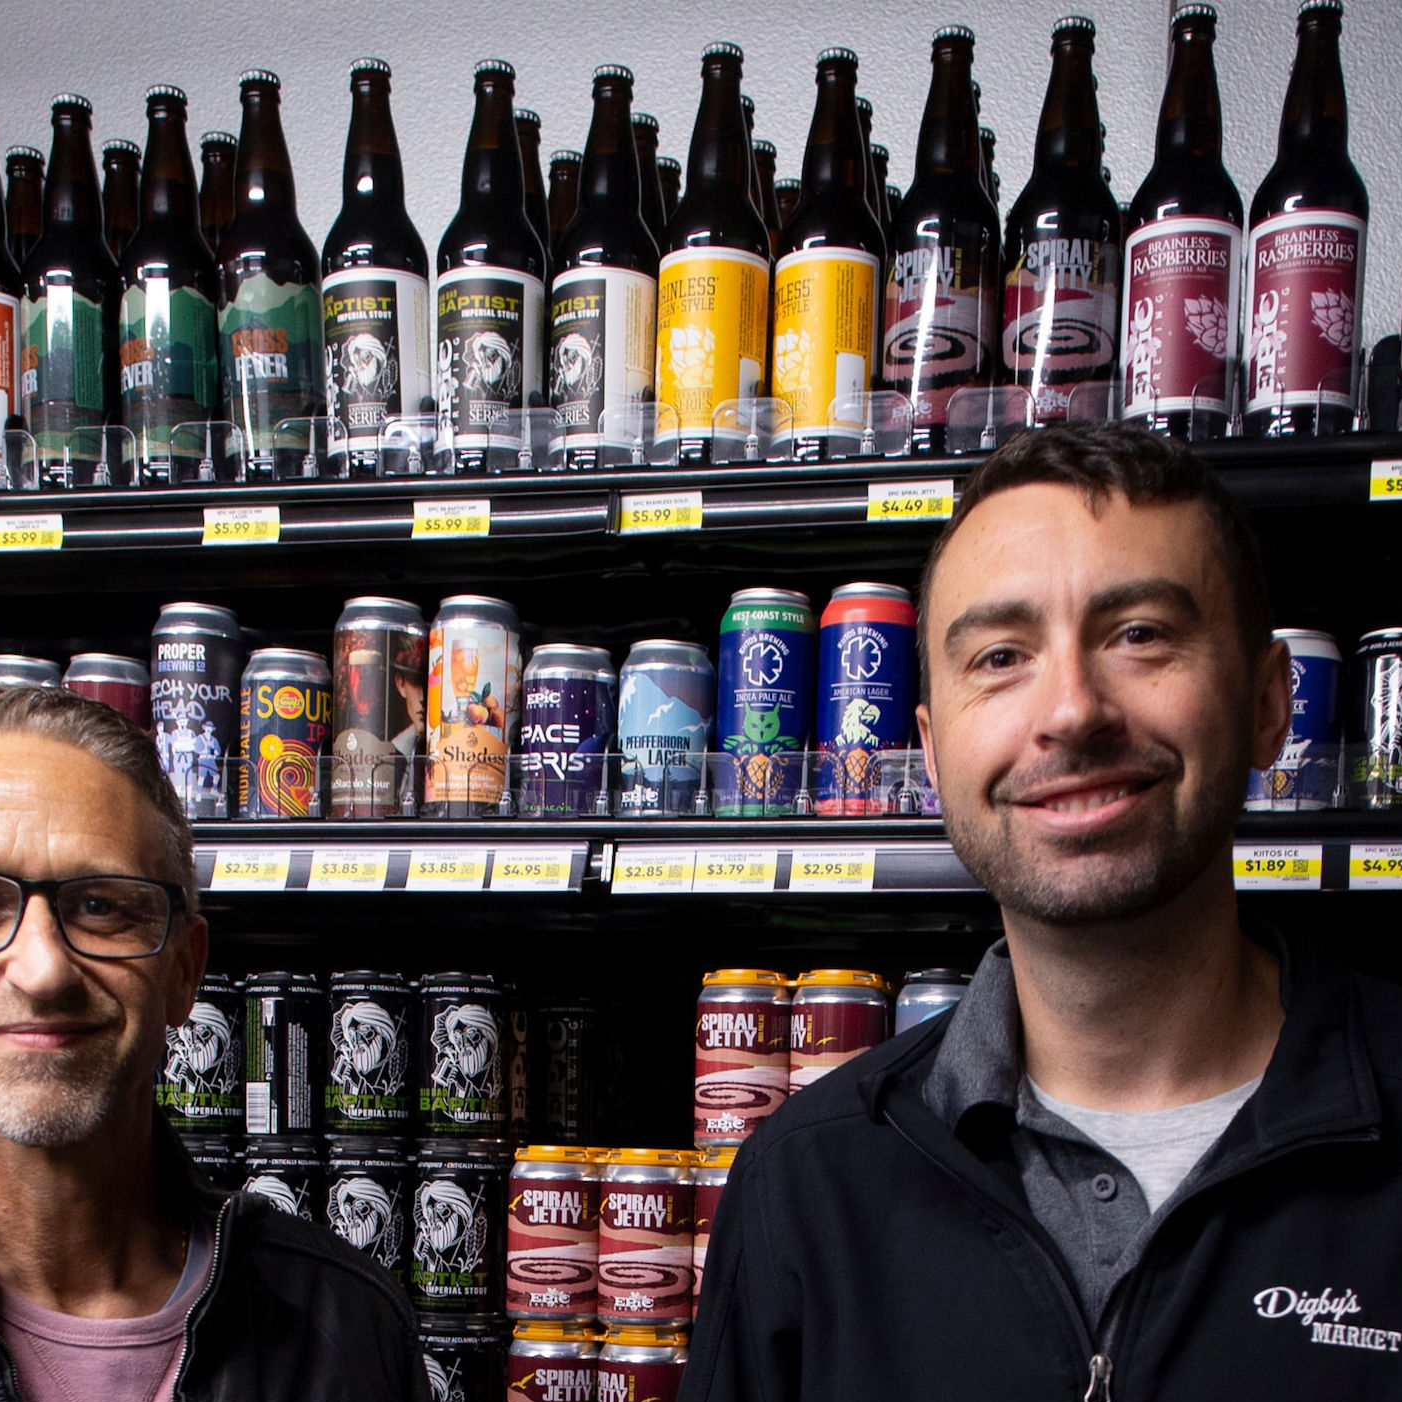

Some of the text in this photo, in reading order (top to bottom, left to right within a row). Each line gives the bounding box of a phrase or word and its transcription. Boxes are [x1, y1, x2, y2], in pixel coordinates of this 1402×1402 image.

[1274, 229, 1340, 247] BRAINLESS
[1027, 238, 1091, 268] SPIRAL
[1148, 237, 1211, 256] BRAINLESS
[1133, 251, 1227, 278] RASPBERRIES
[1258, 244, 1355, 270] RASPBERRIES
[438, 296, 519, 317] BAPTIST
[461, 309, 519, 320] IMPERIAL STOUT
[578, 309, 600, 320] STOUT
[337, 309, 392, 322] IMPERIAL STOUT
[232, 329, 289, 354] CROSS
[348, 411, 388, 426] SERIES
[469, 410, 509, 426] SERIES
[881, 499, 923, 513] $4.49
[632, 509, 672, 523] $5.99
[214, 522, 250, 536] $5.99
[424, 518, 463, 532] $5.99
[1, 531, 37, 544] $5.99
[782, 611, 805, 623] STYLE
[759, 633, 790, 656] BREWING
[857, 627, 889, 649] BREWING
[158, 643, 206, 661] PROPER
[158, 660, 194, 673] BREWING
[187, 682, 233, 703] YOUR
[736, 692, 792, 703] INDIA PALE ALE
[833, 686, 889, 697] AMERICAN LAGER
[152, 700, 206, 721] HEAD
[256, 685, 332, 724] SOUR
[239, 687, 251, 805] INDIA PALE ALE
[625, 735, 690, 751] PFEIFFERHORN
[443, 744, 506, 766] Shades
[648, 749, 687, 767] LAGER
[1253, 849, 1299, 858] KIITOS ICE
[225, 862, 259, 875] $2.75
[321, 862, 358, 875] $3.85
[419, 862, 456, 874] $3.85
[503, 864, 541, 876] $4.95
[625, 866, 663, 878] $2.85
[707, 863, 744, 876] $3.79
[803, 862, 842, 875] $2.95
[1245, 859, 1286, 873] $1.89
[701, 1013, 757, 1031] SPIRAL
[706, 1029, 757, 1048] JETTY
[185, 1106, 221, 1116] IMPERIAL
[348, 1108, 386, 1119] IMPERIAL
[454, 1111, 490, 1122] IMPERIAL
[523, 1189, 583, 1208] SPIRAL
[608, 1192, 666, 1211] SPIRAL
[528, 1206, 581, 1225] JETTY
[613, 1209, 667, 1228] JETTY
[426, 1285, 487, 1296] IMPERIAL STOUT
[1253, 1286, 1361, 1326] Digby's
[1311, 1322, 1401, 1352] MARKET
[535, 1368, 593, 1387] SPIRAL
[542, 1384, 593, 1402] JETTY
